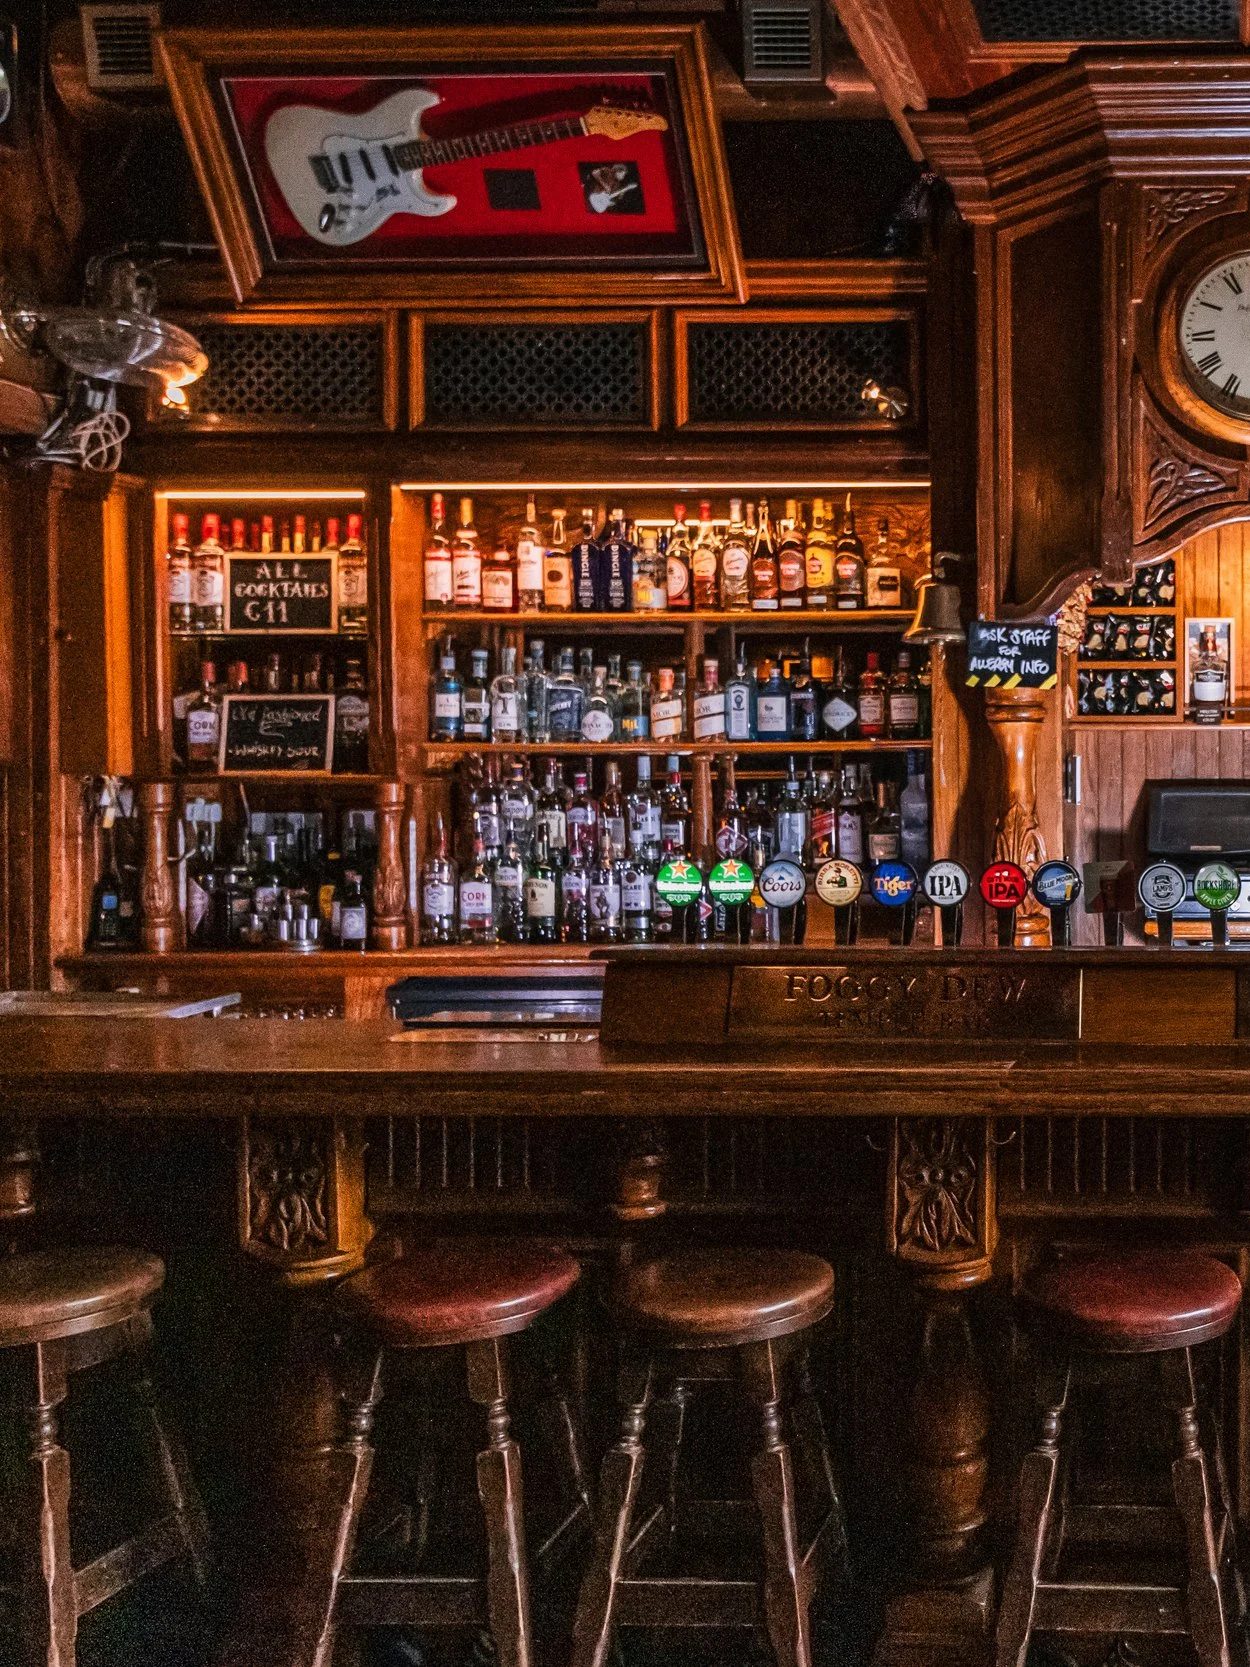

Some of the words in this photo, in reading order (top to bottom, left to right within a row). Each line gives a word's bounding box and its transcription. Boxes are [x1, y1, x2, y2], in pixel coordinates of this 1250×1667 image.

[581, 544, 590, 578] DINGLE
[611, 544, 620, 578] DINGLE
[256, 562, 308, 579] ALL
[234, 581, 329, 598] COCKTAILS
[979, 627, 1008, 643] ASK
[1010, 629, 1051, 647] STAFF
[998, 645, 1022, 657] FOR
[1020, 659, 1050, 675] INFO
[818, 863, 834, 886] BIRRA
[834, 861, 859, 885] MORETTI
[762, 878, 802, 892] Coors
[873, 875, 913, 897] Tiger
[929, 875, 963, 897] IPA
[988, 883, 1021, 899] IPA
[1038, 880, 1055, 891] BLUE
[1055, 874, 1073, 884] MOON
[1198, 879, 1235, 891] ROCKSHORE
[1199, 893, 1217, 905] APPLE
[1217, 893, 1232, 905] CIDER
[784, 975, 917, 1002] FOGGY
